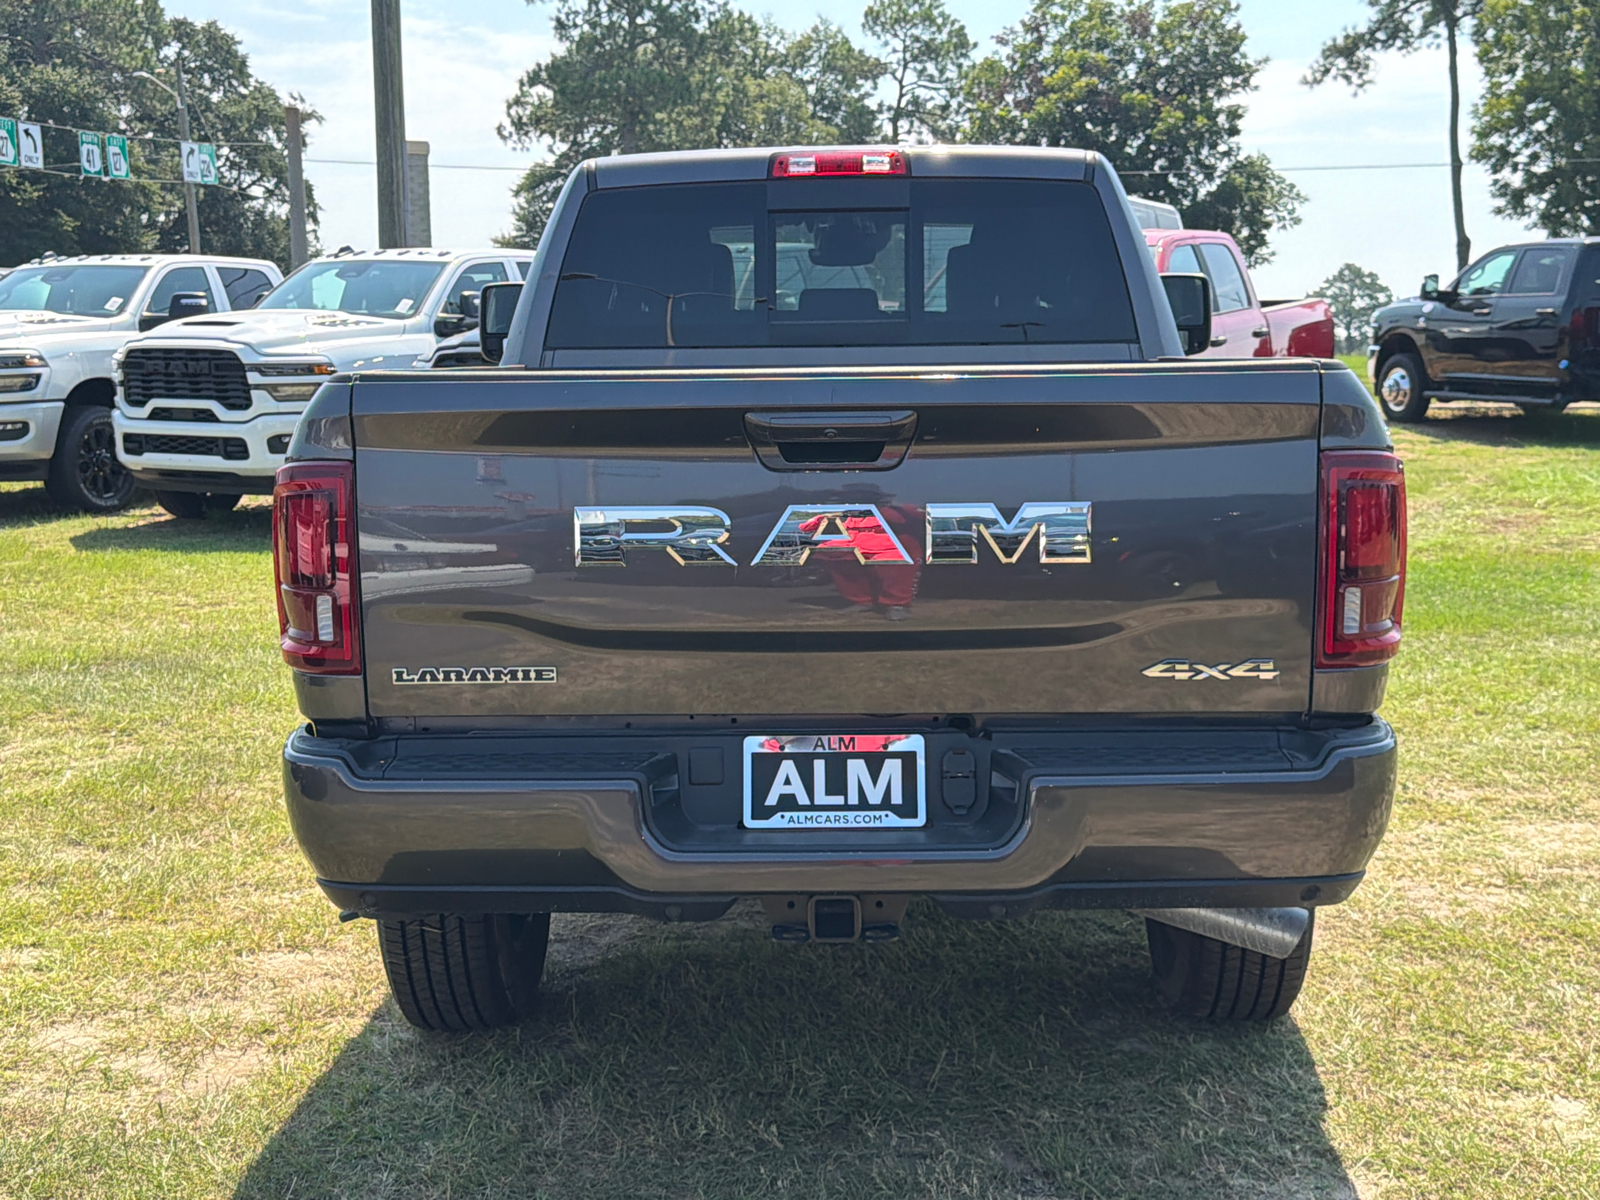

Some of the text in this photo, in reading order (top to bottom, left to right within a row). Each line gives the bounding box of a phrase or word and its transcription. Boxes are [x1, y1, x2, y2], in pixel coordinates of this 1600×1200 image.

[24, 154, 40, 164] ONLY
[86, 148, 96, 169] 41
[573, 501, 1093, 567] RAM
[392, 667, 557, 685] LARAMIE
[812, 736, 856, 752] ALM
[764, 758, 903, 806] ALM
[787, 814, 883, 825] ALMCARS.COM
